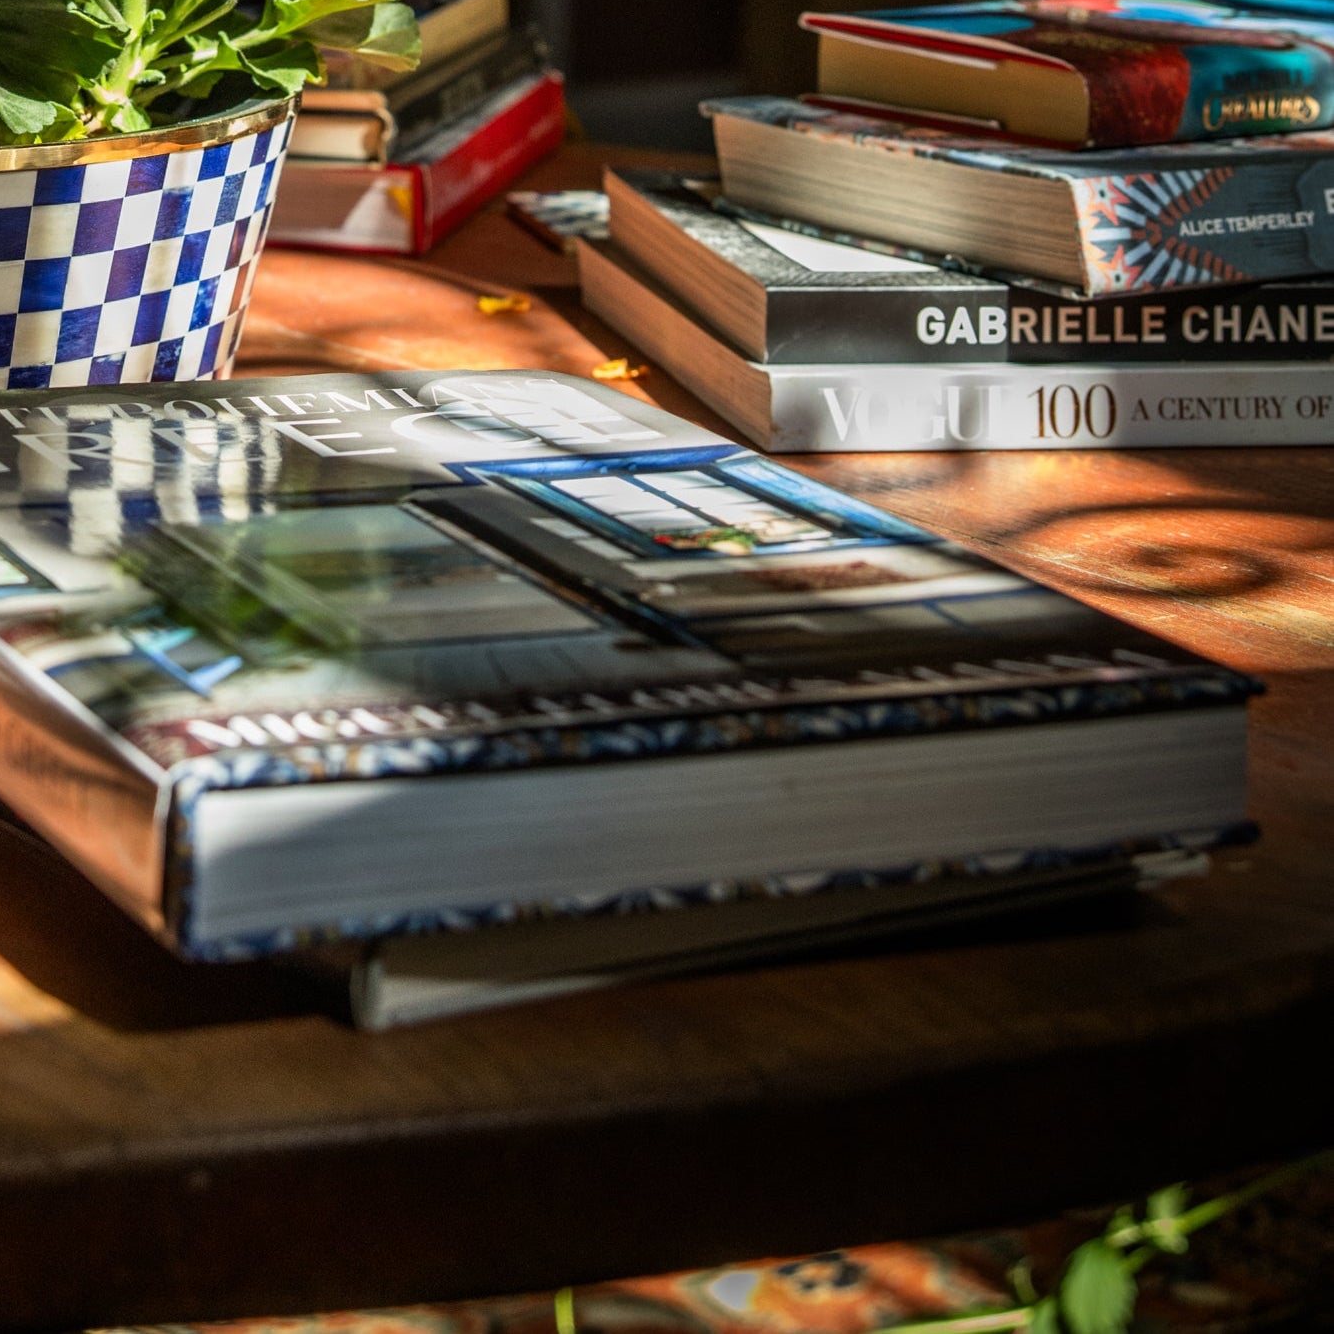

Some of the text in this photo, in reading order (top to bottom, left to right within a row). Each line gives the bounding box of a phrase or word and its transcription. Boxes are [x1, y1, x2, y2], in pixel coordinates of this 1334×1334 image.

[1179, 210, 1315, 237] ALICE TEMPERLEY
[916, 304, 1334, 345] GABRIELLE CHANE
[1027, 383, 1117, 439] 100
[1131, 398, 1151, 422] A
[1157, 396, 1288, 422] CENTURY
[1295, 395, 1334, 420] OF
